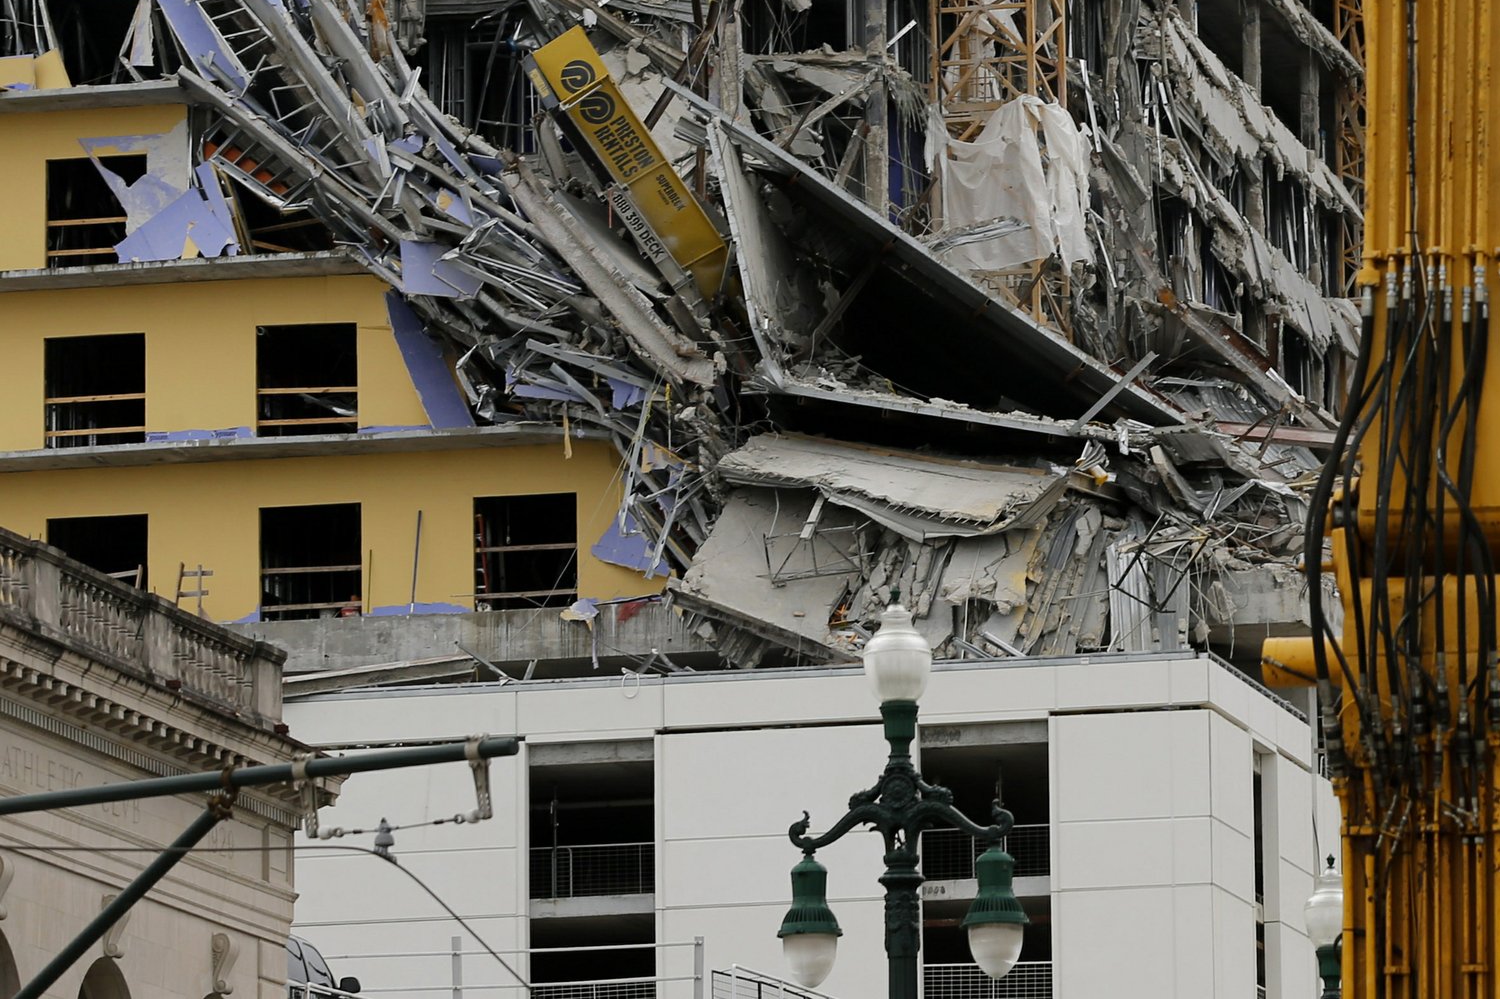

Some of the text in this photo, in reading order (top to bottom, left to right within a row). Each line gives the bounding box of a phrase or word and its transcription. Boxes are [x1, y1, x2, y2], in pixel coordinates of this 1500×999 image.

[594, 126, 639, 178] RENTALS
[610, 116, 655, 169] PRESTON
[626, 211, 645, 231] 399
[639, 231, 665, 259] DECK
